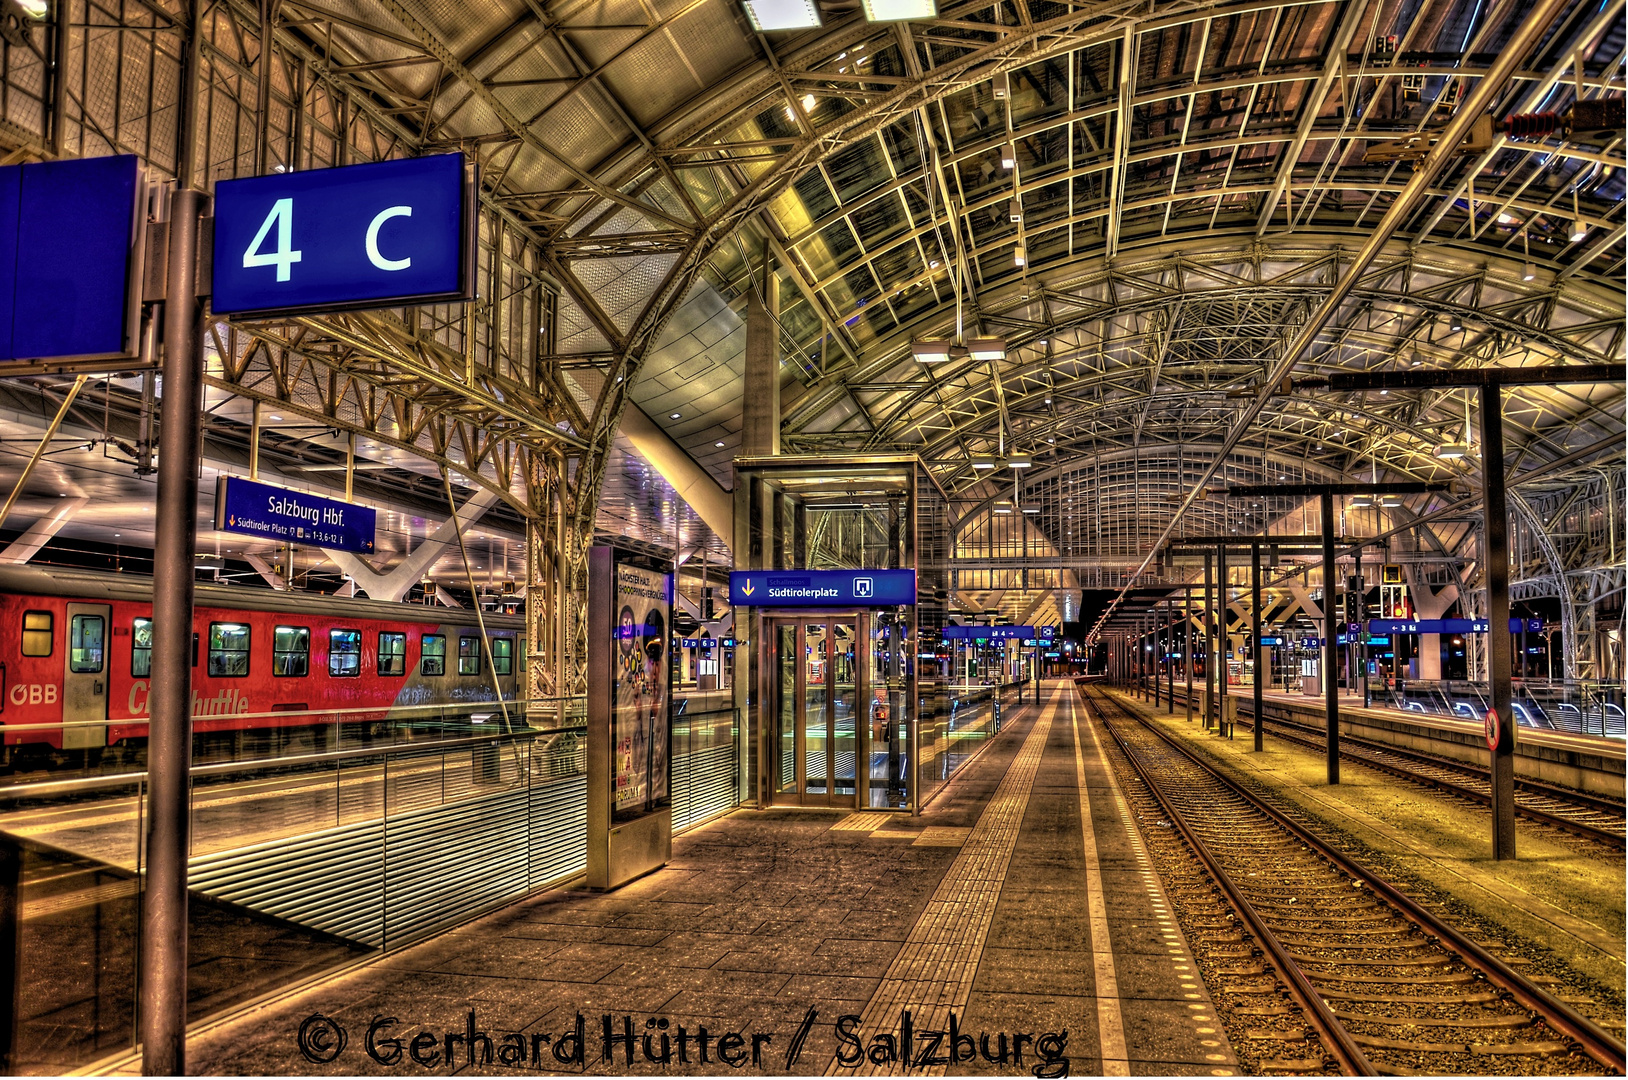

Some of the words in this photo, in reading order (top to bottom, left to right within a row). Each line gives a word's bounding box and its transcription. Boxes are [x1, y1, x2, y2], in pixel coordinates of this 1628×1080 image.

[243, 198, 302, 282] 4
[268, 496, 320, 525] Salzburg
[323, 507, 345, 527] Hbf.
[237, 517, 270, 532] Südtiroler
[272, 523, 288, 535] Platz
[768, 587, 838, 598] Südtirolerplatz
[10, 684, 58, 706] ÖBB
